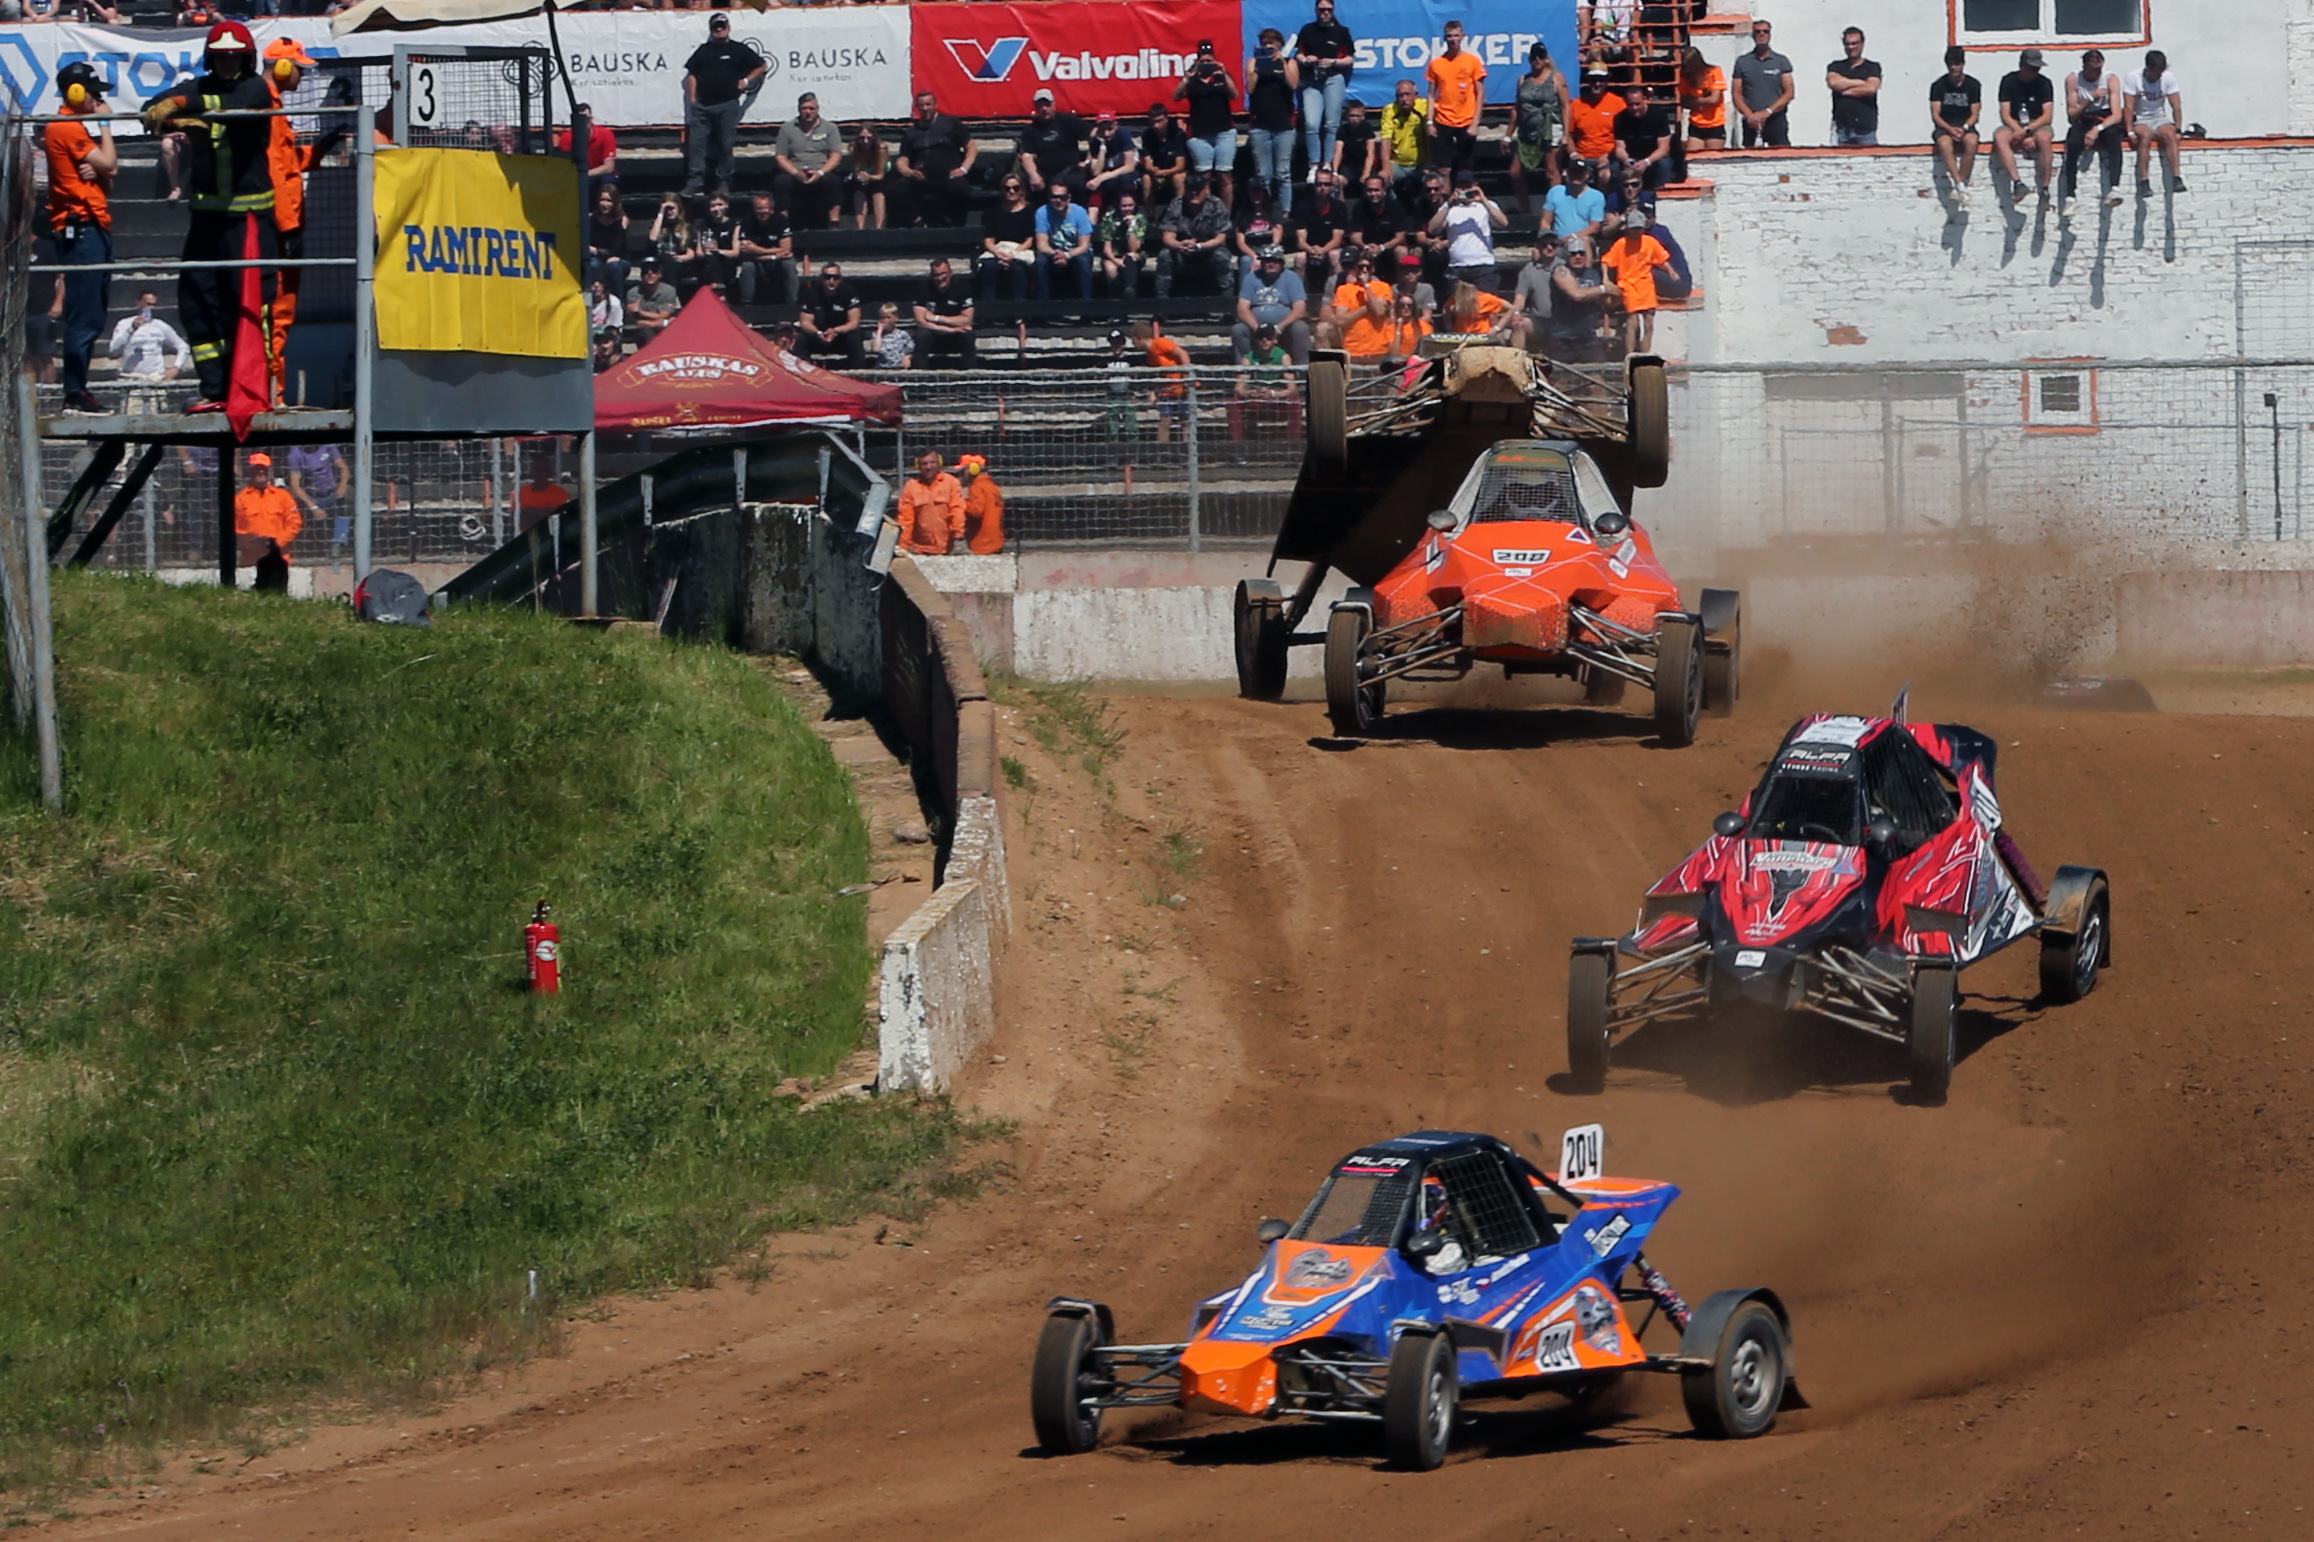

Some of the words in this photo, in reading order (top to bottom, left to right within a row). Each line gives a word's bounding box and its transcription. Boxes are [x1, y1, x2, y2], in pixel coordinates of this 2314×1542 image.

[570, 53, 669, 74] BAUSKA
[789, 48, 888, 69] BAUSKA
[418, 68, 436, 122] 3
[404, 224, 557, 280] RAMIRENT
[635, 355, 761, 377] BAUSKAS
[1347, 1155, 1411, 1167] ALFA
[1566, 1130, 1598, 1178] 204
[1540, 1329, 1575, 1368] 204
